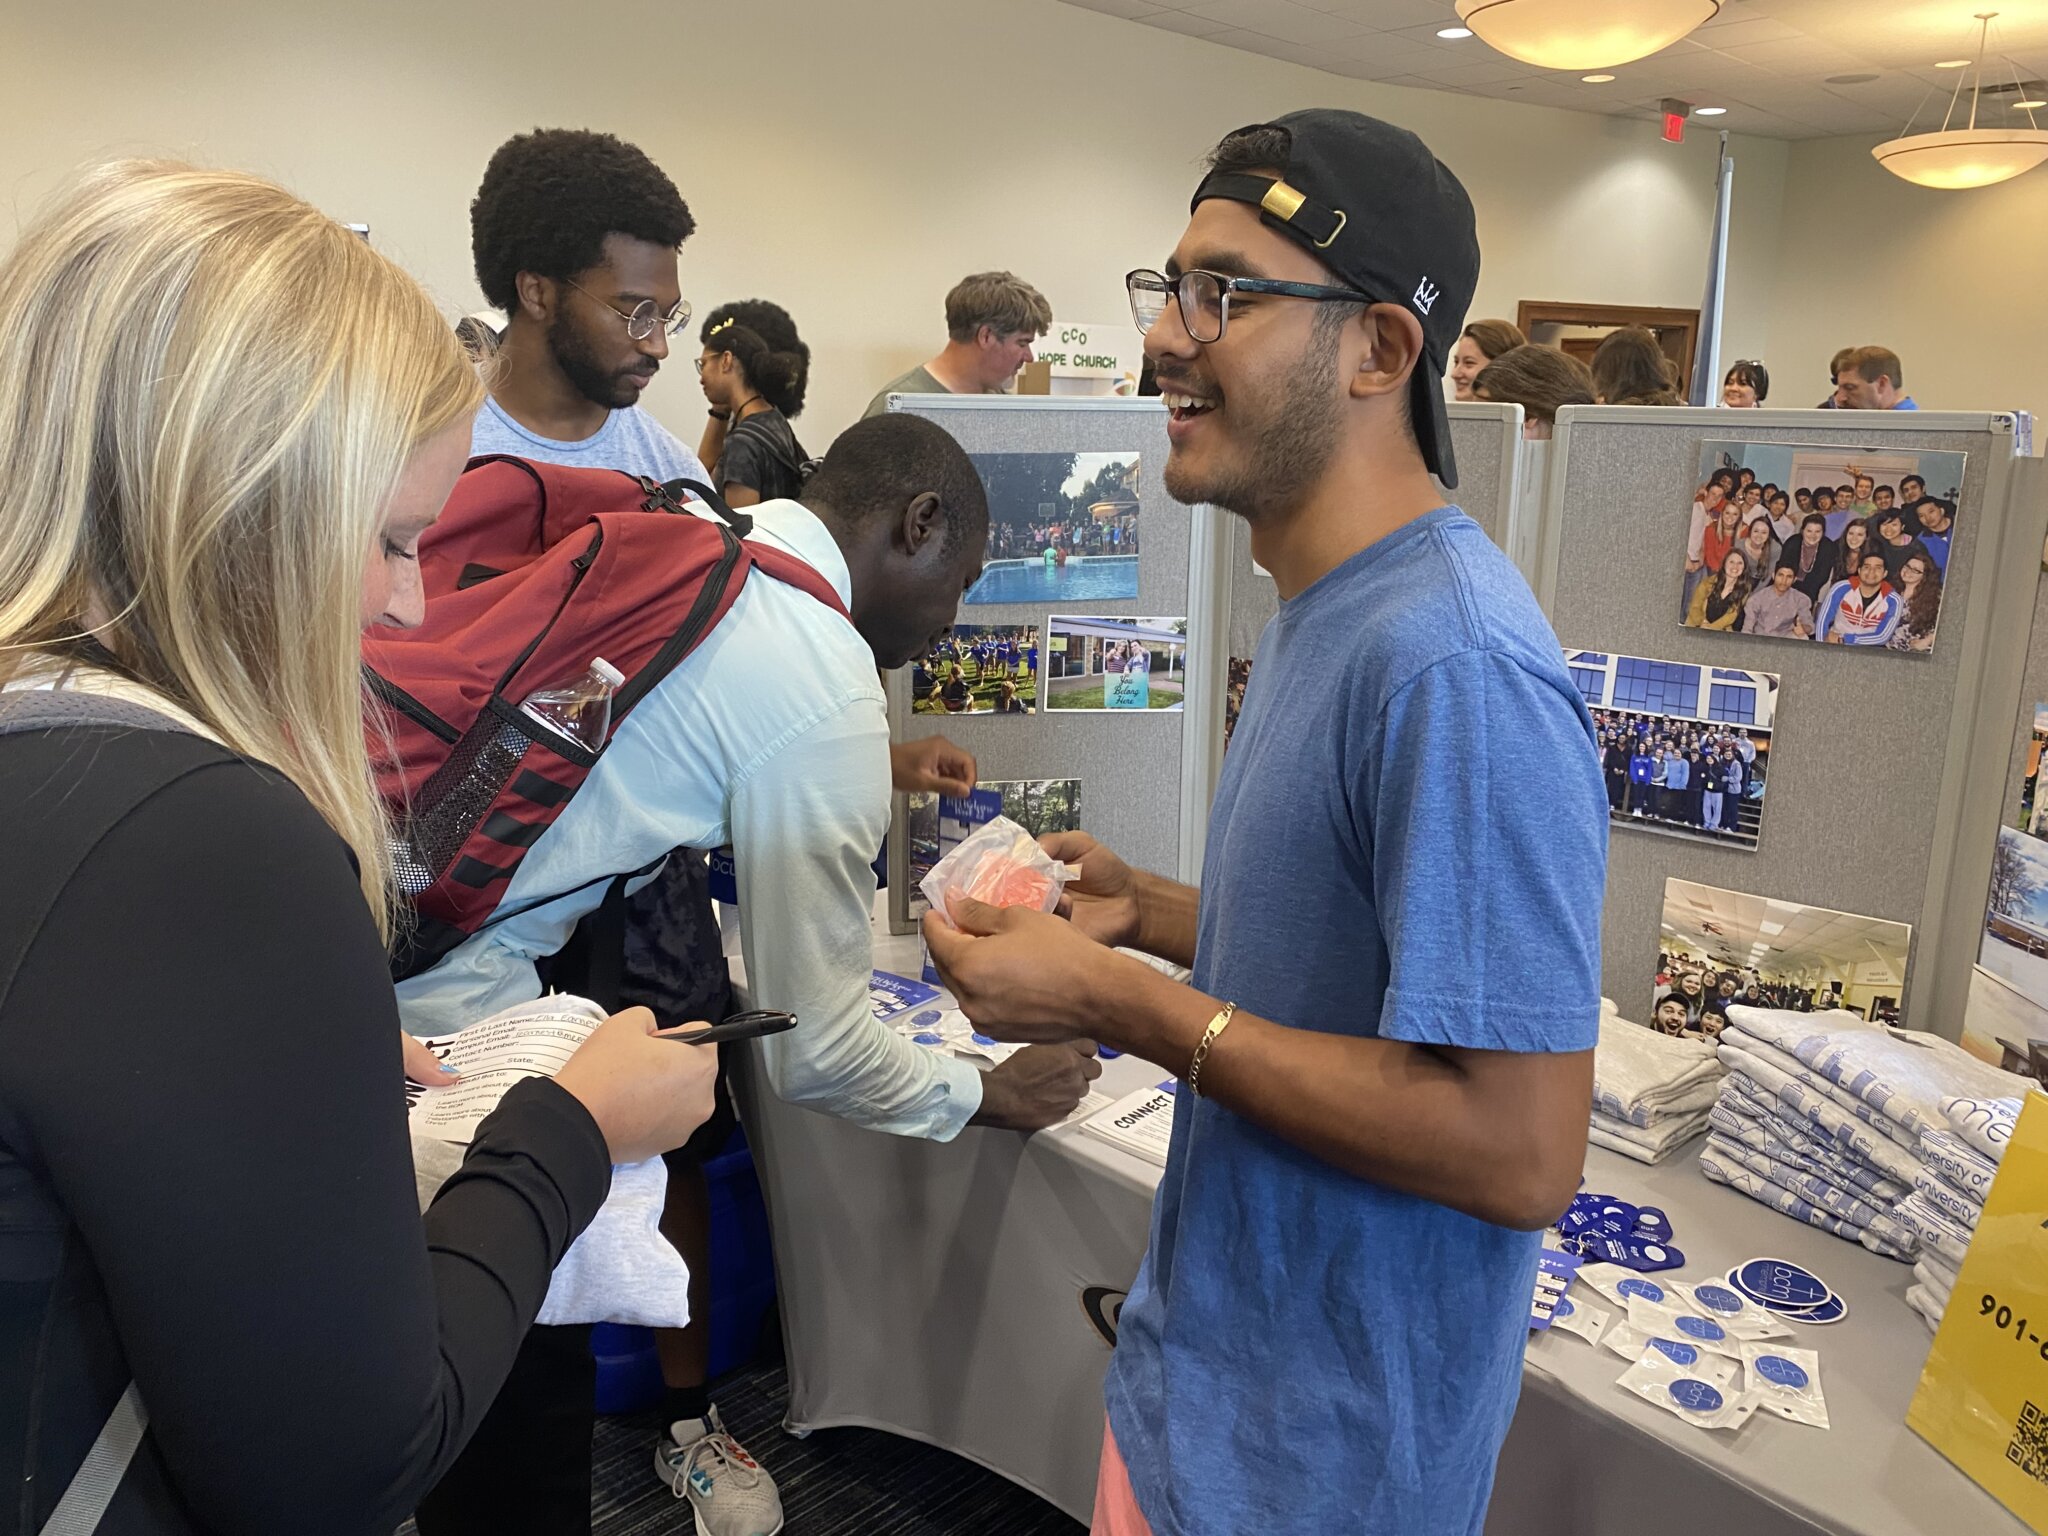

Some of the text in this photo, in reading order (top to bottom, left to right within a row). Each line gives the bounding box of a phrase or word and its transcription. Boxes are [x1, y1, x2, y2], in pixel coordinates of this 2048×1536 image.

[1038, 352, 1117, 369] HOPE CHURCH
[488, 1021, 507, 1030] Last
[455, 1031, 491, 1046] Personal
[452, 1040, 485, 1053] Campus
[448, 1048, 482, 1061] Contact
[1113, 1094, 1173, 1129] CONNECT
[1972, 1173, 1990, 1188] of
[1914, 1176, 1977, 1222] university
[1927, 1231, 1941, 1244] of
